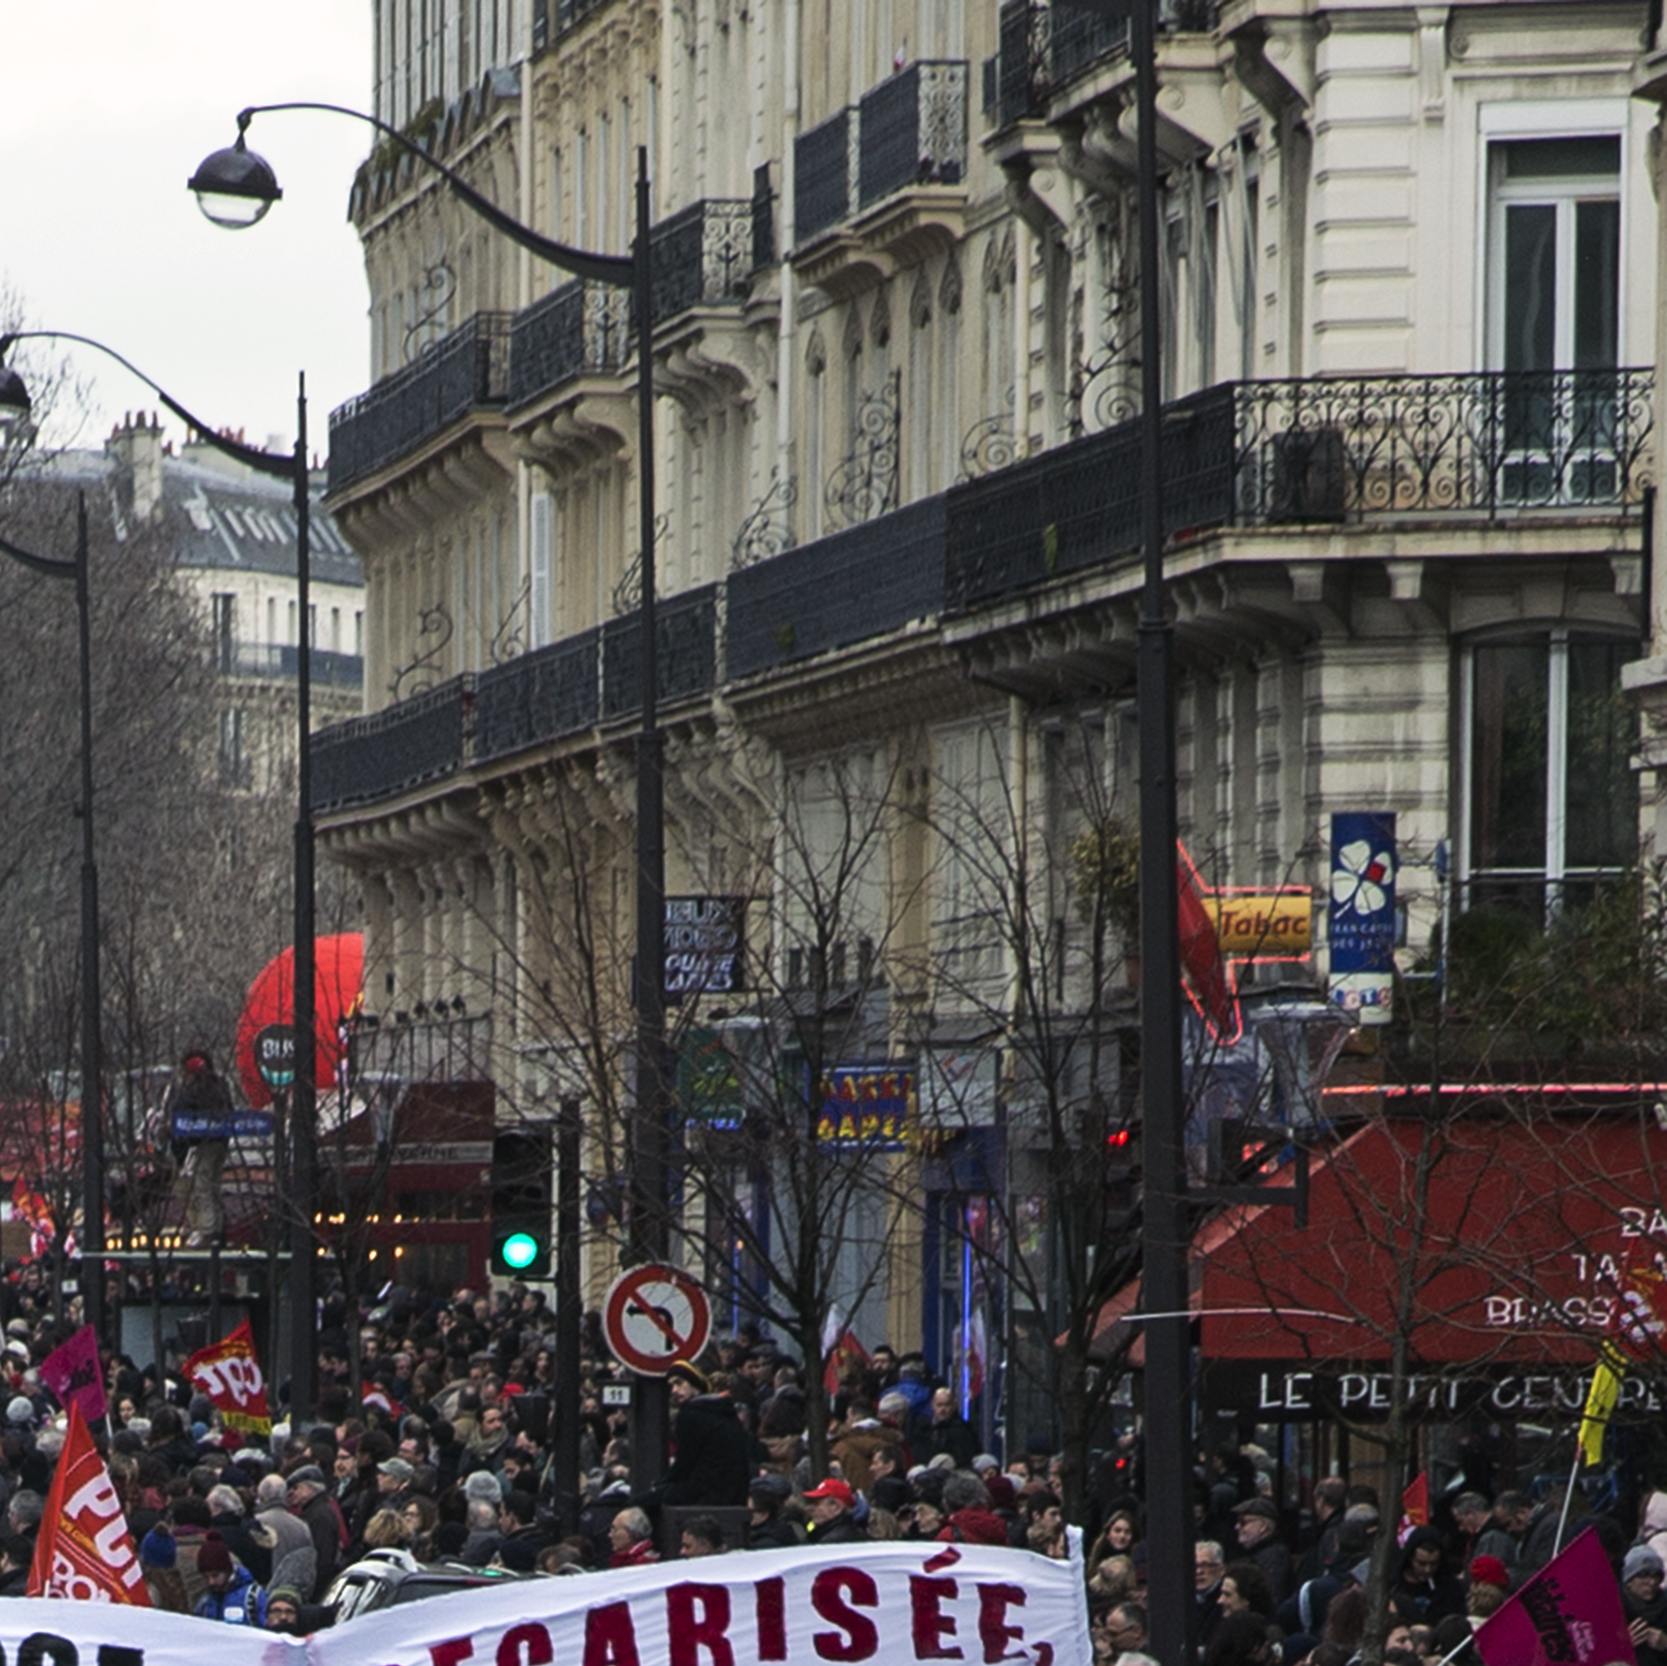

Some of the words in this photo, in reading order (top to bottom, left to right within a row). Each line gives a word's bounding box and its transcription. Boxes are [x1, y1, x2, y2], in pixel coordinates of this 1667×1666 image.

[1221, 911, 1308, 936] Tabac
[1258, 1372, 1313, 1409] LE
[1337, 1372, 1464, 1409] PETIT
